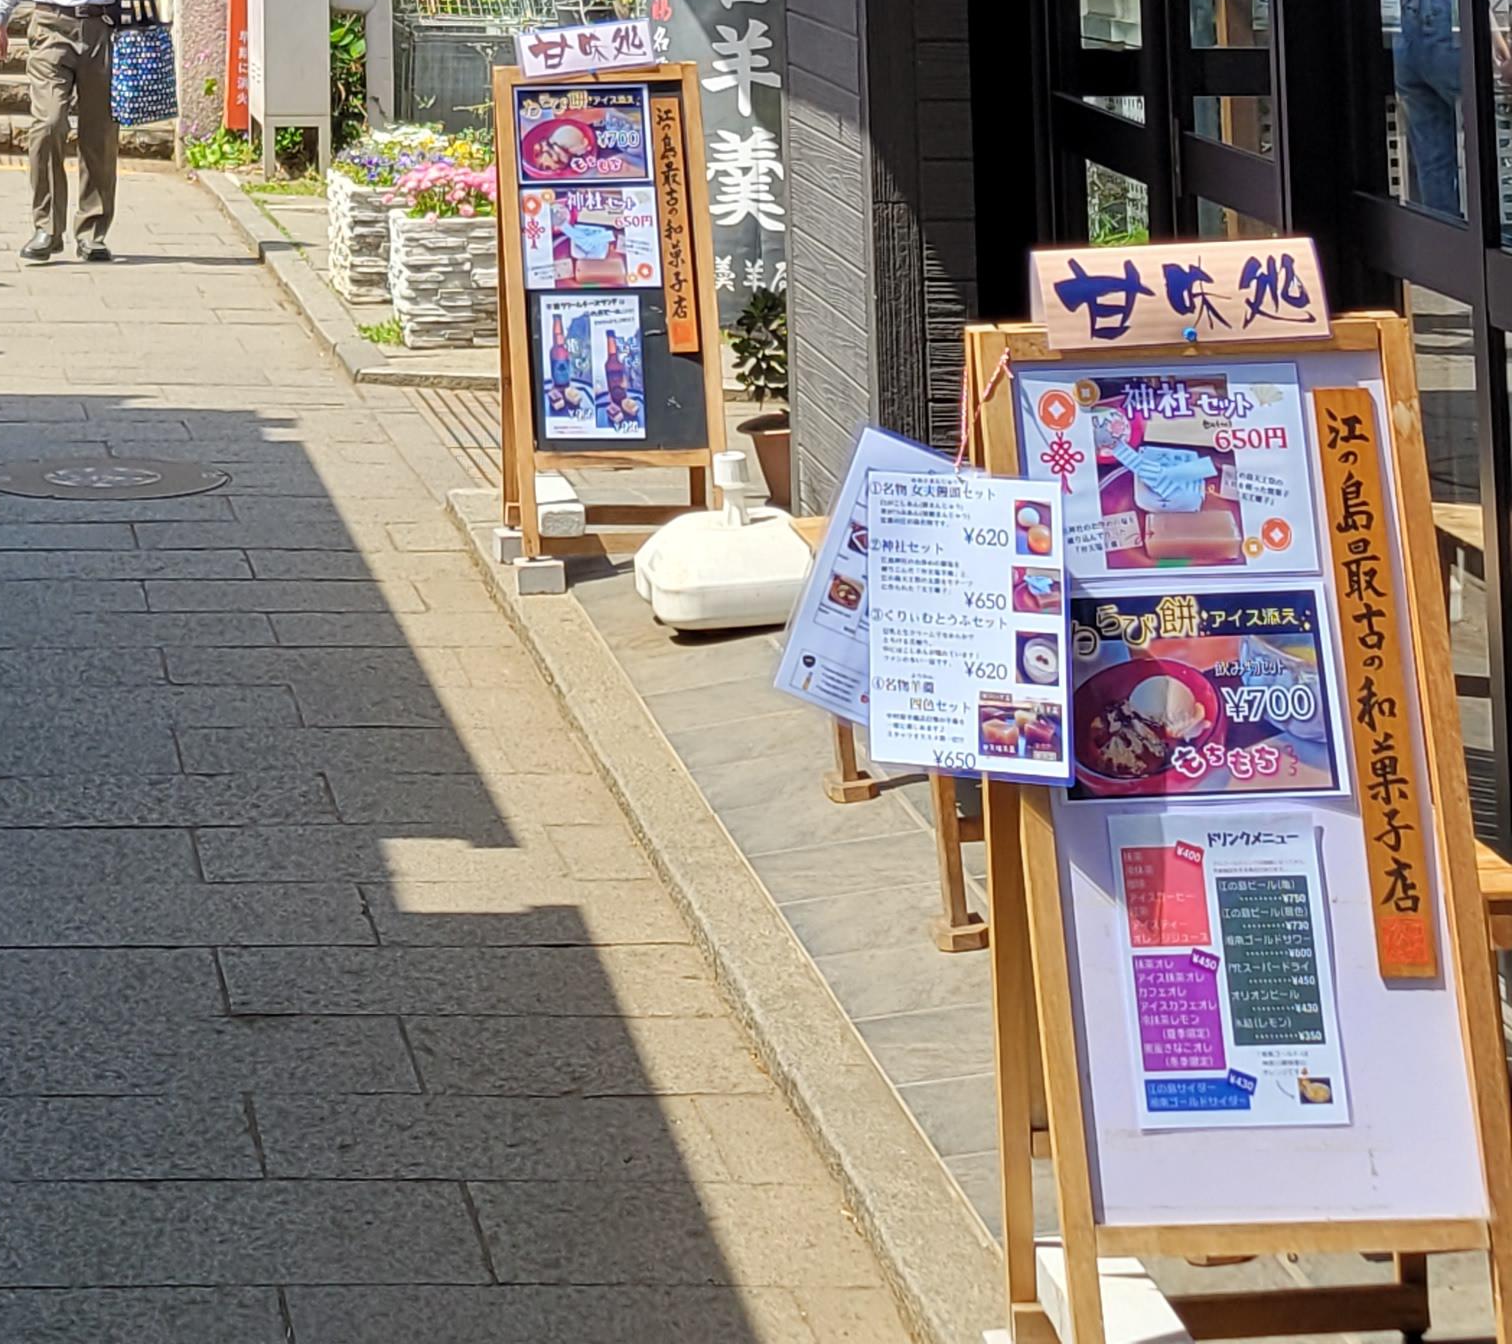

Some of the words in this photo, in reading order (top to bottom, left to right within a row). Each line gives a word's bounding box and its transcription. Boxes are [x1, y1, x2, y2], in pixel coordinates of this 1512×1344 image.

[528, 24, 647, 70] 甘味処
[596, 129, 640, 148] ¥700
[567, 191, 638, 211] 神社セット
[614, 215, 654, 228] 650円
[656, 106, 689, 320] 江の島最古の和菓子店
[1053, 253, 1317, 340] 甘味処
[1121, 381, 1254, 420] 神社セット
[1214, 426, 1289, 451] 650円
[963, 527, 1009, 547] ¥620
[963, 591, 1008, 611] ¥650
[1071, 596, 1200, 658] わらび餅
[1210, 607, 1300, 628] アイス添え
[1326, 406, 1422, 914] 江の島最古の和菓子店
[964, 661, 1008, 680] ¥620
[910, 697, 972, 714] 四色セット
[1220, 683, 1316, 724] ¥700
[932, 749, 977, 769] ¥650
[1170, 743, 1280, 779] もちもち
[1207, 831, 1299, 848] ドリンクメニュー
[1176, 845, 1202, 863] ¥400
[1133, 932, 1210, 945] オレンジジュース
[1139, 986, 1187, 998] カフェオレ
[1231, 990, 1300, 1001] オリオンビール
[1141, 1000, 1218, 1012] アイスカフェオレ
